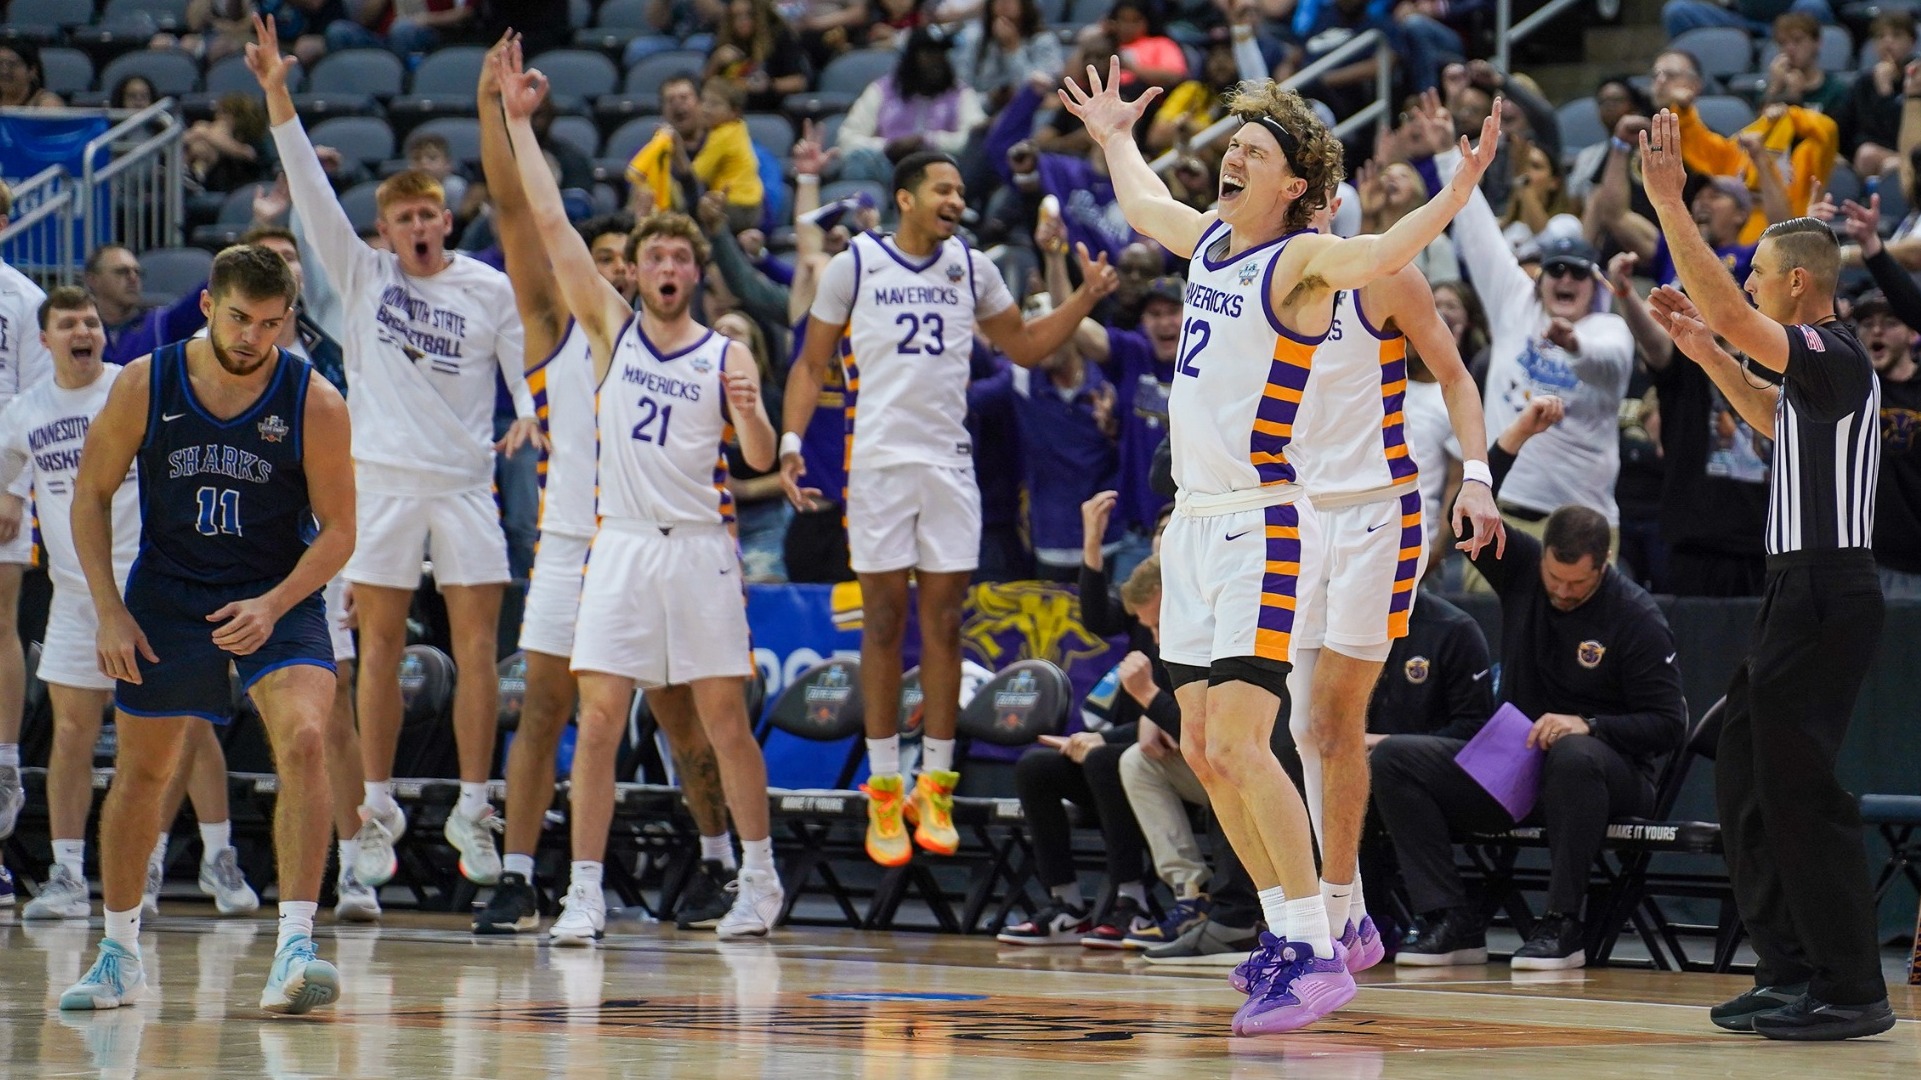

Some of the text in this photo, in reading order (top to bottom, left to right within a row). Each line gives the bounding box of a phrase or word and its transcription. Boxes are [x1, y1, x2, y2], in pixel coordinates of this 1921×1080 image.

[875, 286, 959, 305] MAVERICKS
[433, 307, 466, 338] STATE
[896, 313, 944, 355] 23
[1176, 316, 1211, 378] 12
[622, 363, 702, 402] MAVERICKS
[632, 395, 672, 447] 21
[168, 444, 272, 483] SHARKS
[195, 486, 243, 537] 11
[1606, 824, 1677, 841] MAKE IT YOURS
